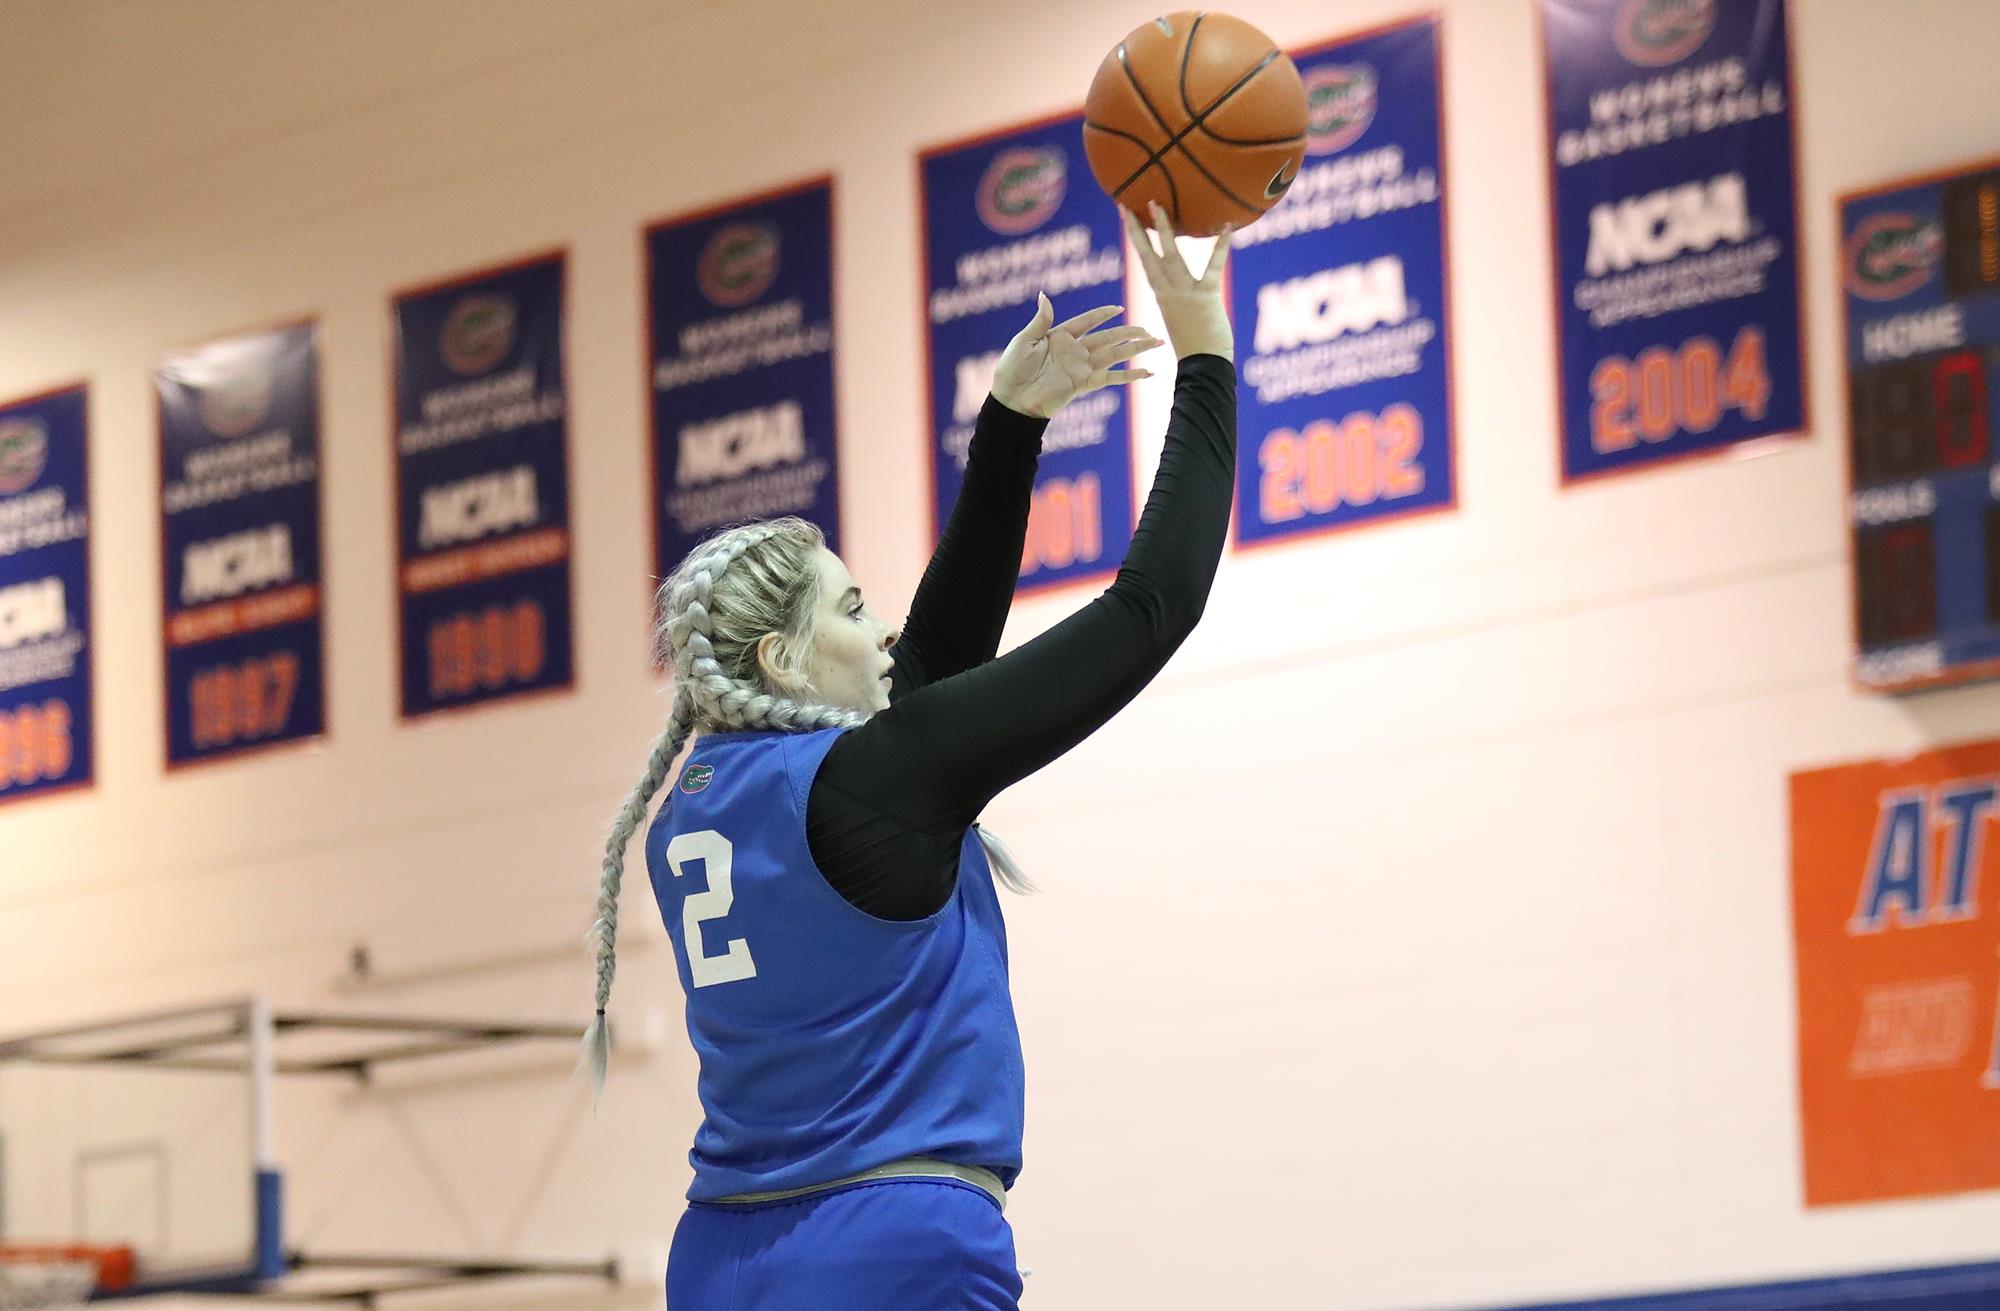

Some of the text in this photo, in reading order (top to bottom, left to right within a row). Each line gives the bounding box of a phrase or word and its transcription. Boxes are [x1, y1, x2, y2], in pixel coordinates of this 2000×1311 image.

[1583, 171, 1751, 278] NCAA
[1253, 254, 1408, 356] NCAA
[1863, 302, 1962, 364] HOME
[1589, 324, 1772, 453] 2004
[1932, 352, 1986, 470] 0
[675, 400, 806, 487] NCAA
[1259, 401, 1426, 525] 2002
[417, 463, 541, 550] NCAA
[180, 522, 293, 604] NCAA
[666, 830, 757, 989] 2
